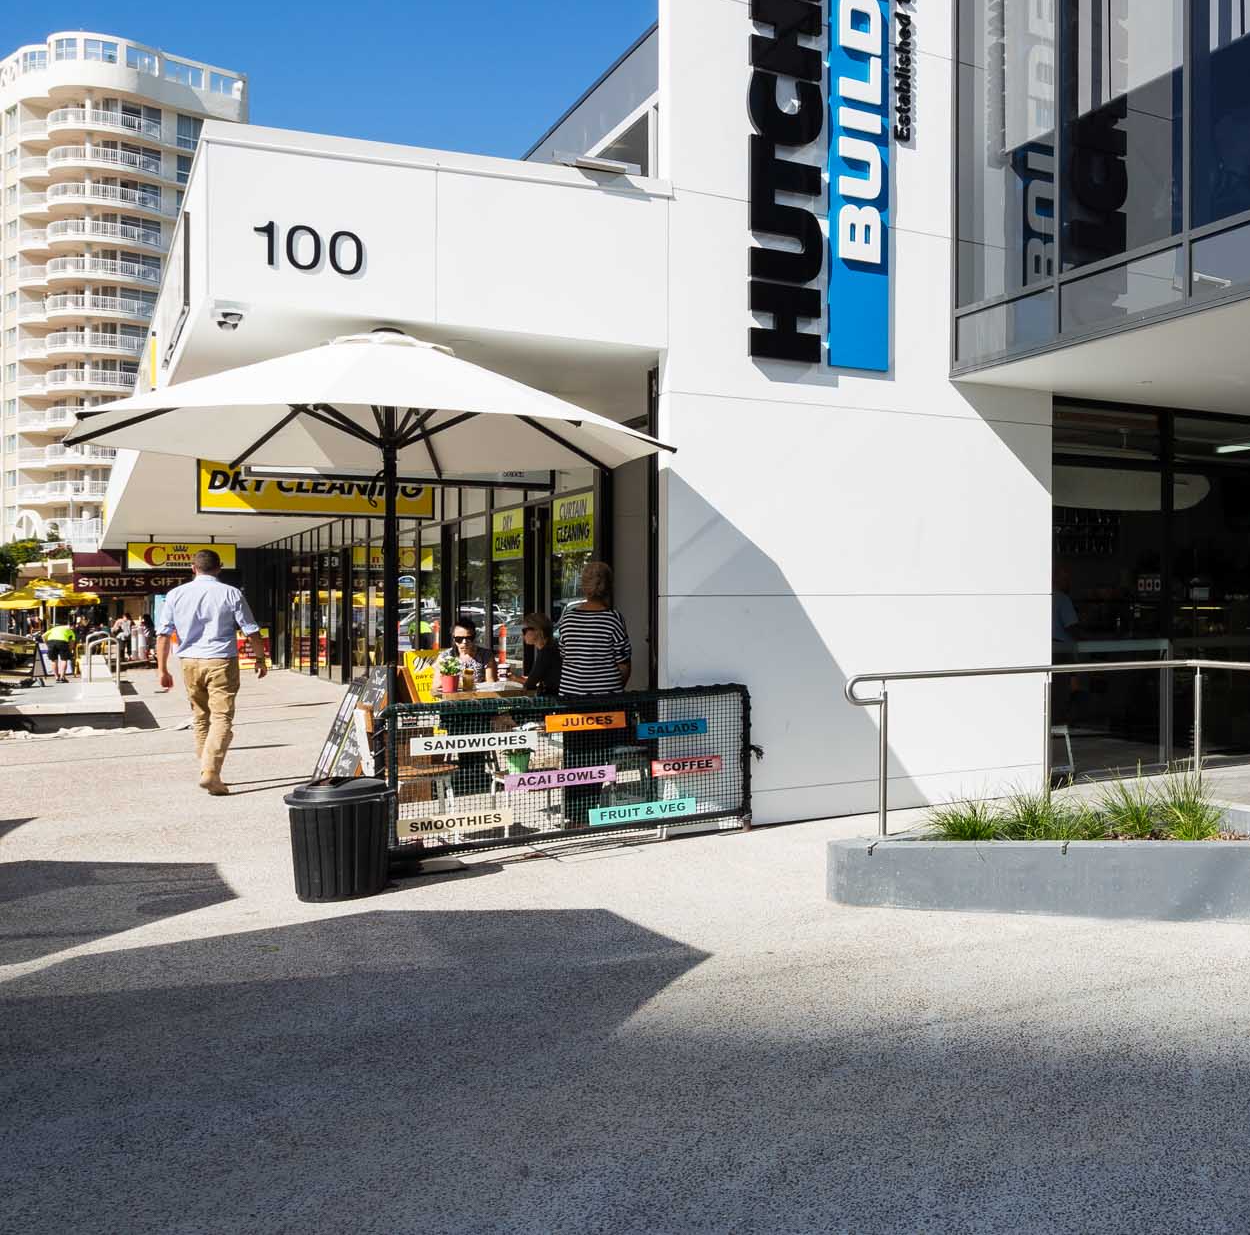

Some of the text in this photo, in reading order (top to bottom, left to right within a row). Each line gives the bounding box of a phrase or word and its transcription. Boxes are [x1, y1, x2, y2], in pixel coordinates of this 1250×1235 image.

[894, 11, 912, 143] Established
[253, 220, 363, 276] 100
[559, 498, 588, 520] CURTAIN
[556, 521, 591, 544] CLEANING
[143, 545, 195, 567] Crow
[78, 576, 145, 588] SPIRIT'S
[561, 715, 614, 728] JUICES
[647, 721, 699, 736] SALADS
[423, 734, 528, 752] SANDWICHES
[662, 758, 714, 773] COFFEE
[516, 769, 607, 788] ACAI BOWLS
[600, 801, 687, 821] FRUIT & VEG
[408, 813, 503, 833] SMOOTHIES
